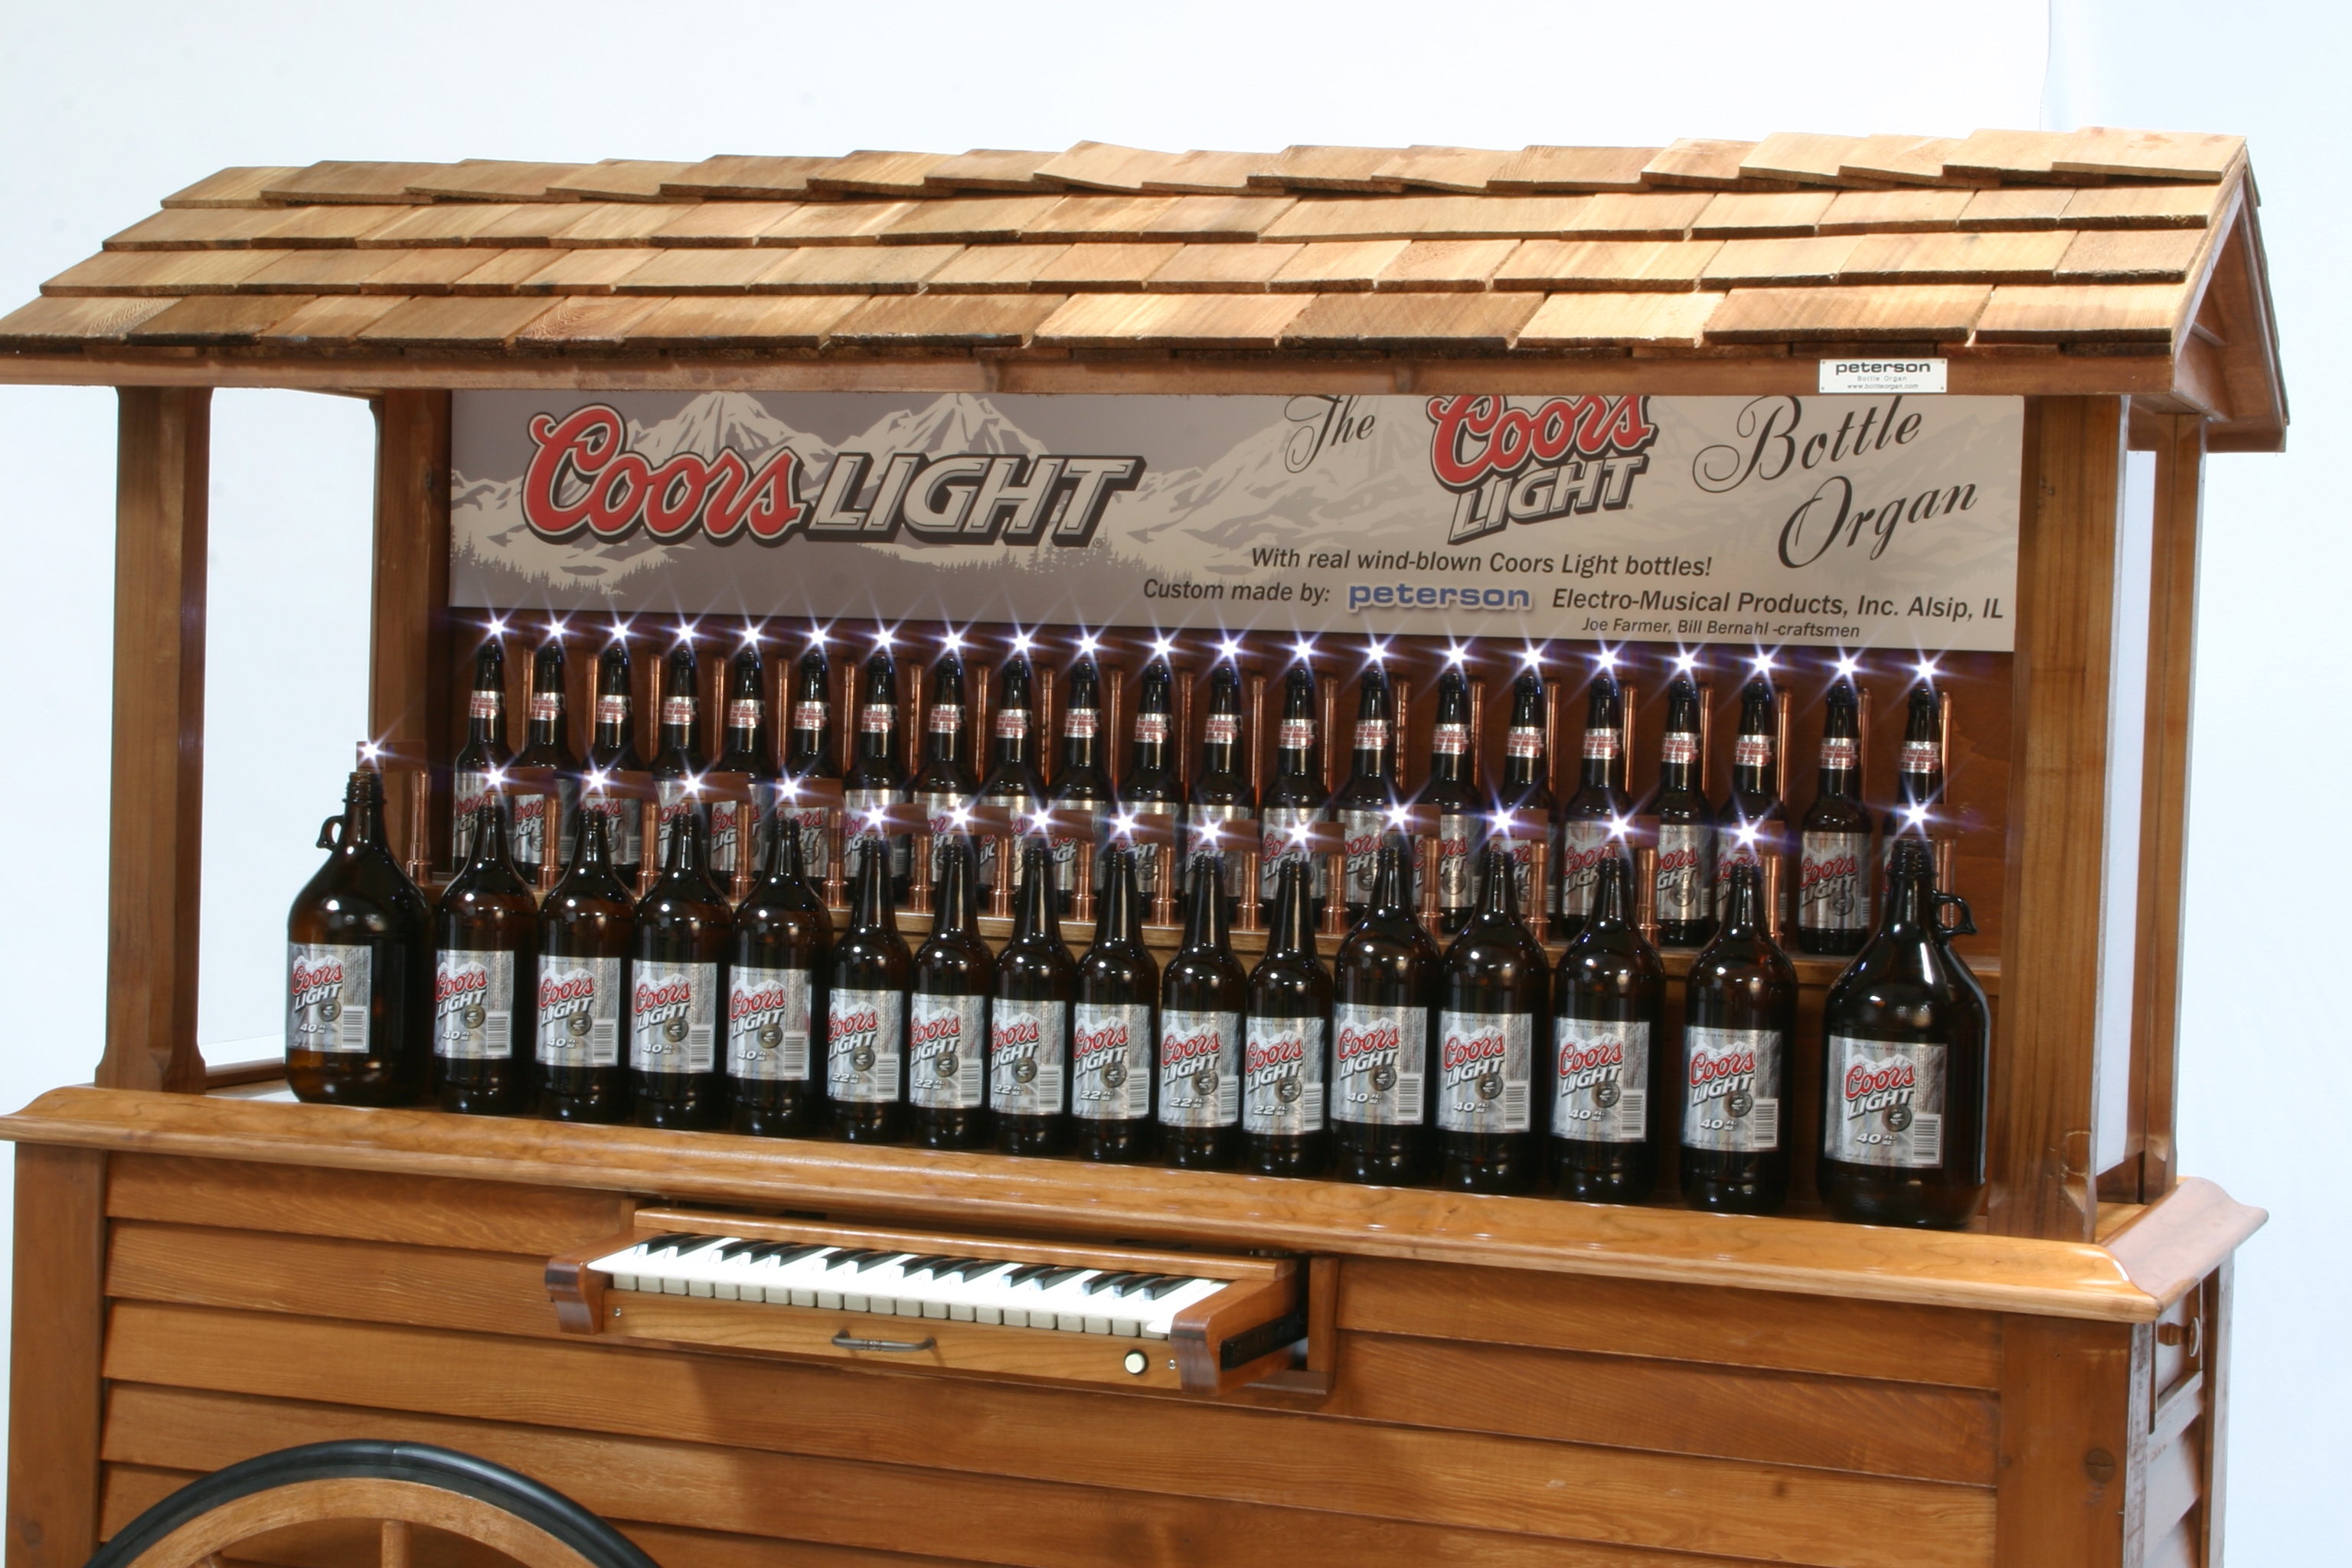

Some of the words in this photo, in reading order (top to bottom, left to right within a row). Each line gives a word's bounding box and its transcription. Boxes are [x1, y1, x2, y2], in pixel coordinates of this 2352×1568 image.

[1835, 362, 1931, 375] peterson
[1284, 395, 1376, 474] The
[1426, 395, 1659, 492] Coors
[1693, 395, 1922, 492] Bottle
[521, 403, 808, 546] Coors
[808, 452, 1146, 547] LIGHT
[1448, 453, 1649, 545] LIGHT
[1778, 475, 1978, 568] Organ
[1252, 547, 1301, 568] With
[1307, 549, 1350, 569] real
[1357, 550, 1482, 572] wind-blown
[1489, 552, 1554, 573] Coors
[1561, 554, 1618, 578] Light
[1625, 555, 1712, 577] bottles!
[1144, 578, 1224, 600] Custom
[1230, 582, 1293, 602] made
[1300, 583, 1331, 606] by:
[1348, 583, 1530, 610] peterson
[1552, 587, 1730, 612] Electro-Musical
[1737, 592, 1848, 619] Products,
[1857, 595, 1899, 617] Inc.
[1907, 596, 1973, 622] Alsip,
[1983, 598, 2004, 619] IL
[1582, 617, 1608, 631] Joe
[1613, 618, 1671, 635] Farmer,
[1677, 619, 1703, 634] Bill
[1707, 620, 1768, 635] Bernahl
[1772, 622, 1860, 638] -craftsmen
[1565, 865, 1599, 895] LIGH
[1801, 855, 1858, 890] Coors
[1802, 876, 1856, 908] LIGHT
[292, 963, 343, 995] Coors
[539, 976, 594, 1009] Coors
[295, 983, 342, 1013] LIGHT
[437, 988, 486, 1019] LIGHT
[541, 996, 593, 1027] LIGHT
[635, 982, 691, 1015] Coors
[730, 988, 786, 1021] Coors
[299, 1024, 317, 1034] 40
[637, 1002, 689, 1033] LIGHT
[732, 1008, 785, 1039] LIGHT
[442, 1031, 459, 1040] 40
[547, 1038, 566, 1048] 40
[642, 1044, 662, 1054] 40
[828, 1031, 877, 1061] LIGHT
[1073, 1025, 1129, 1060] Coors
[1161, 1032, 1220, 1067] Coors
[1338, 1026, 1400, 1061] Coors
[737, 1050, 756, 1060] 40
[910, 1036, 959, 1067] LIGHT
[991, 1042, 1038, 1072] LIGHT
[1075, 1047, 1127, 1080] LIGHT
[1246, 1038, 1303, 1075] Coors
[1340, 1048, 1398, 1080] LIGHT
[1444, 1034, 1505, 1070] Coors
[1559, 1041, 1623, 1077] Coors
[831, 1072, 850, 1083] 22
[914, 1078, 933, 1089] 22
[1164, 1053, 1219, 1086] LIGHT
[1246, 1060, 1302, 1093] LIGHT
[1446, 1057, 1504, 1089] LIGHT
[1560, 1065, 1622, 1096] LIGHT
[1690, 1050, 1756, 1087] Coors
[1845, 1064, 1915, 1101] Coors
[994, 1083, 1011, 1094] 22
[1080, 1090, 1100, 1100] 22
[1170, 1097, 1191, 1108] 22
[1346, 1093, 1369, 1103] 40
[1693, 1073, 1754, 1107] LIGHT
[1847, 1087, 1914, 1120] LIGHT
[1253, 1105, 1274, 1116] 22
[1453, 1101, 1476, 1112] 40
[1568, 1109, 1591, 1120] 40
[1700, 1118, 1723, 1129] 40
[1857, 1132, 1883, 1144] 40
